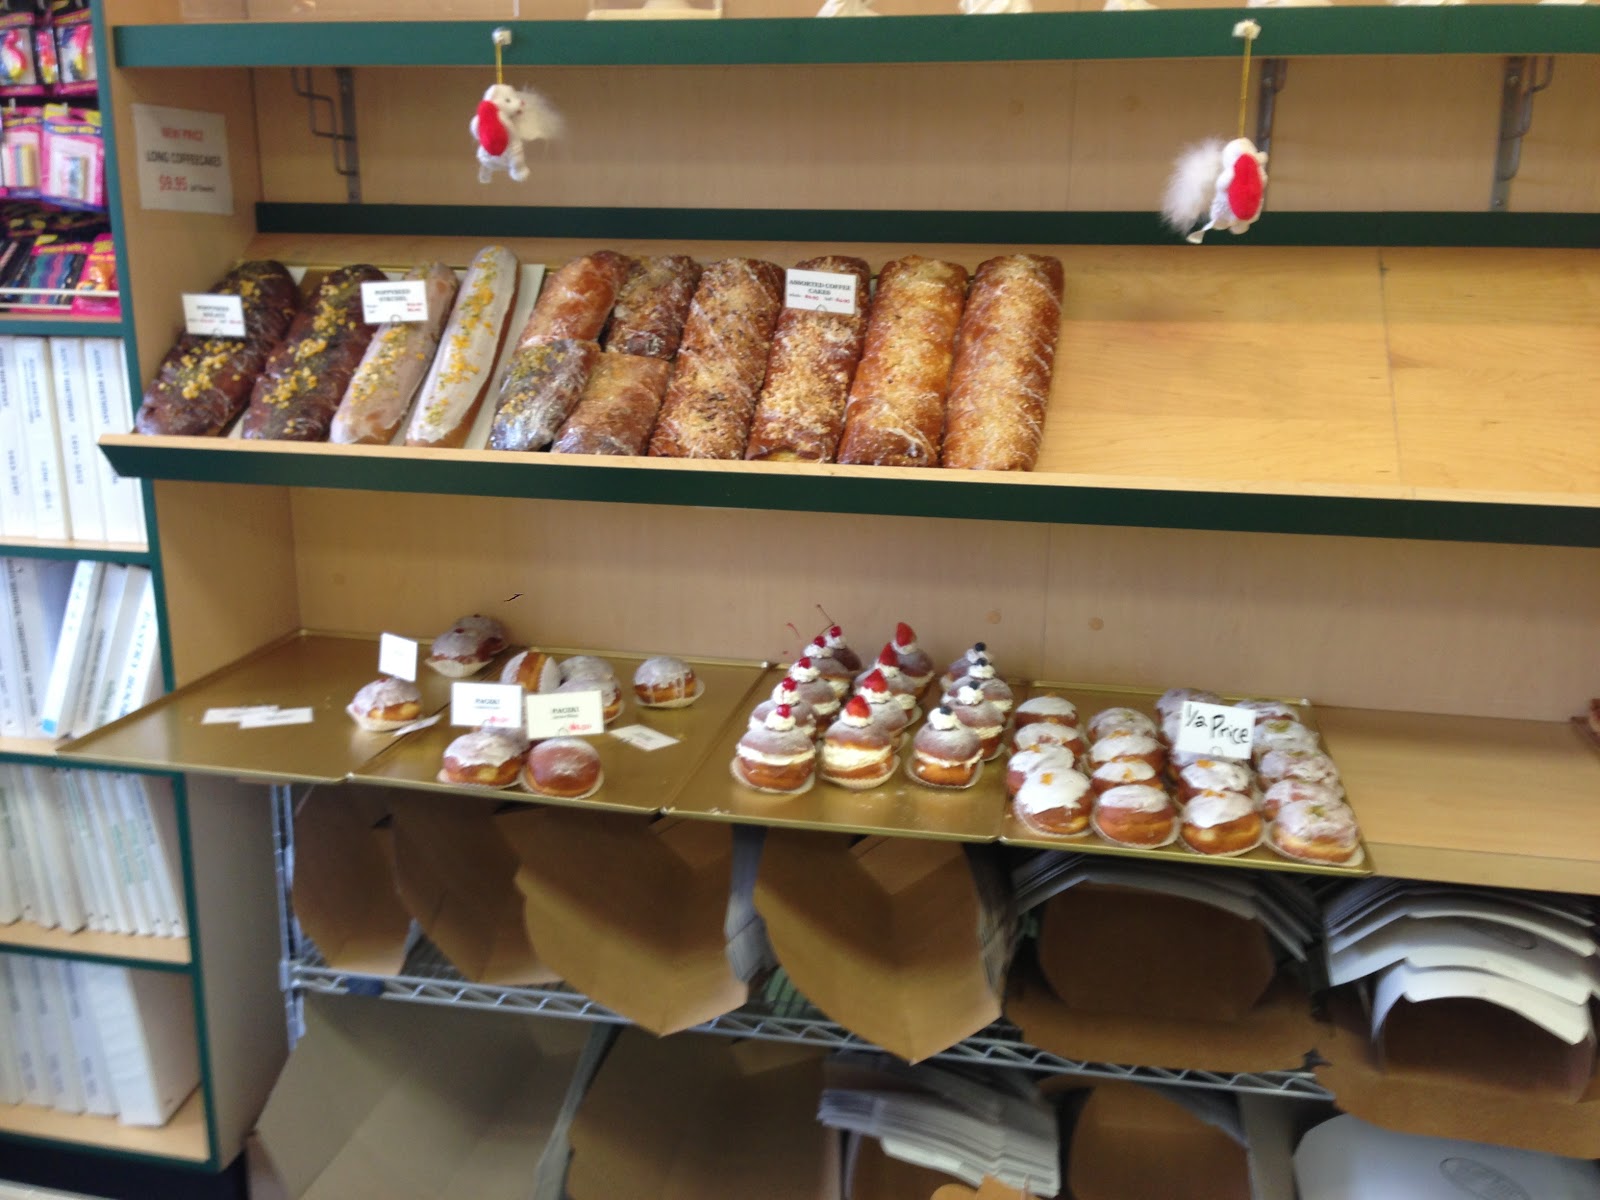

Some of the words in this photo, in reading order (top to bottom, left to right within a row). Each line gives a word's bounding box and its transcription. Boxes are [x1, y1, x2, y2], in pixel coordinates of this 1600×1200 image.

[146, 150, 169, 163] LONG
[789, 280, 824, 288] ASSORTED
[825, 283, 852, 291] COFFEE
[808, 288, 832, 296] CAKES
[1210, 713, 1249, 745] Price
